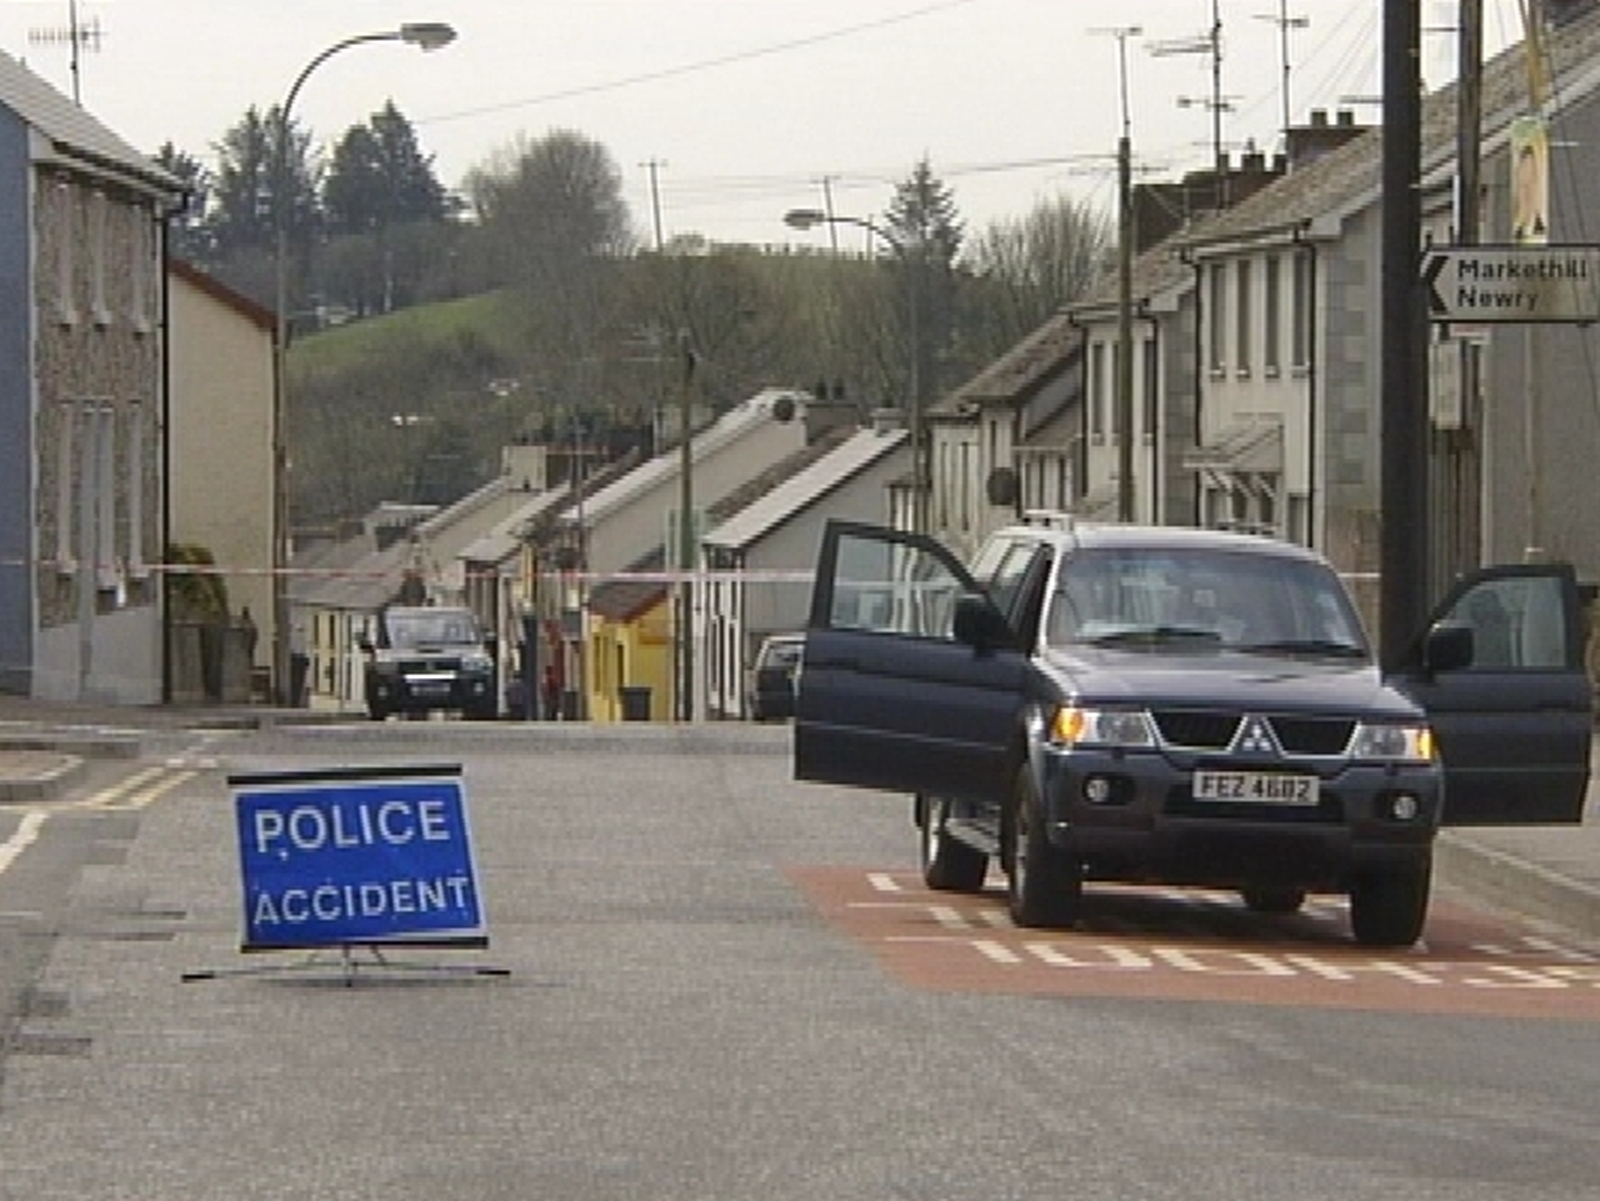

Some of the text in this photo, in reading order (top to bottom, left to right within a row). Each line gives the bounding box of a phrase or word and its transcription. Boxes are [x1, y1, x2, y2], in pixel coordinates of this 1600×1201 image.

[1457, 259, 1588, 280] Markethill
[1457, 286, 1539, 311] Newry
[1201, 774, 1245, 797] FEZ
[254, 800, 450, 853] POLICE
[253, 877, 468, 924] ACCIDENT
